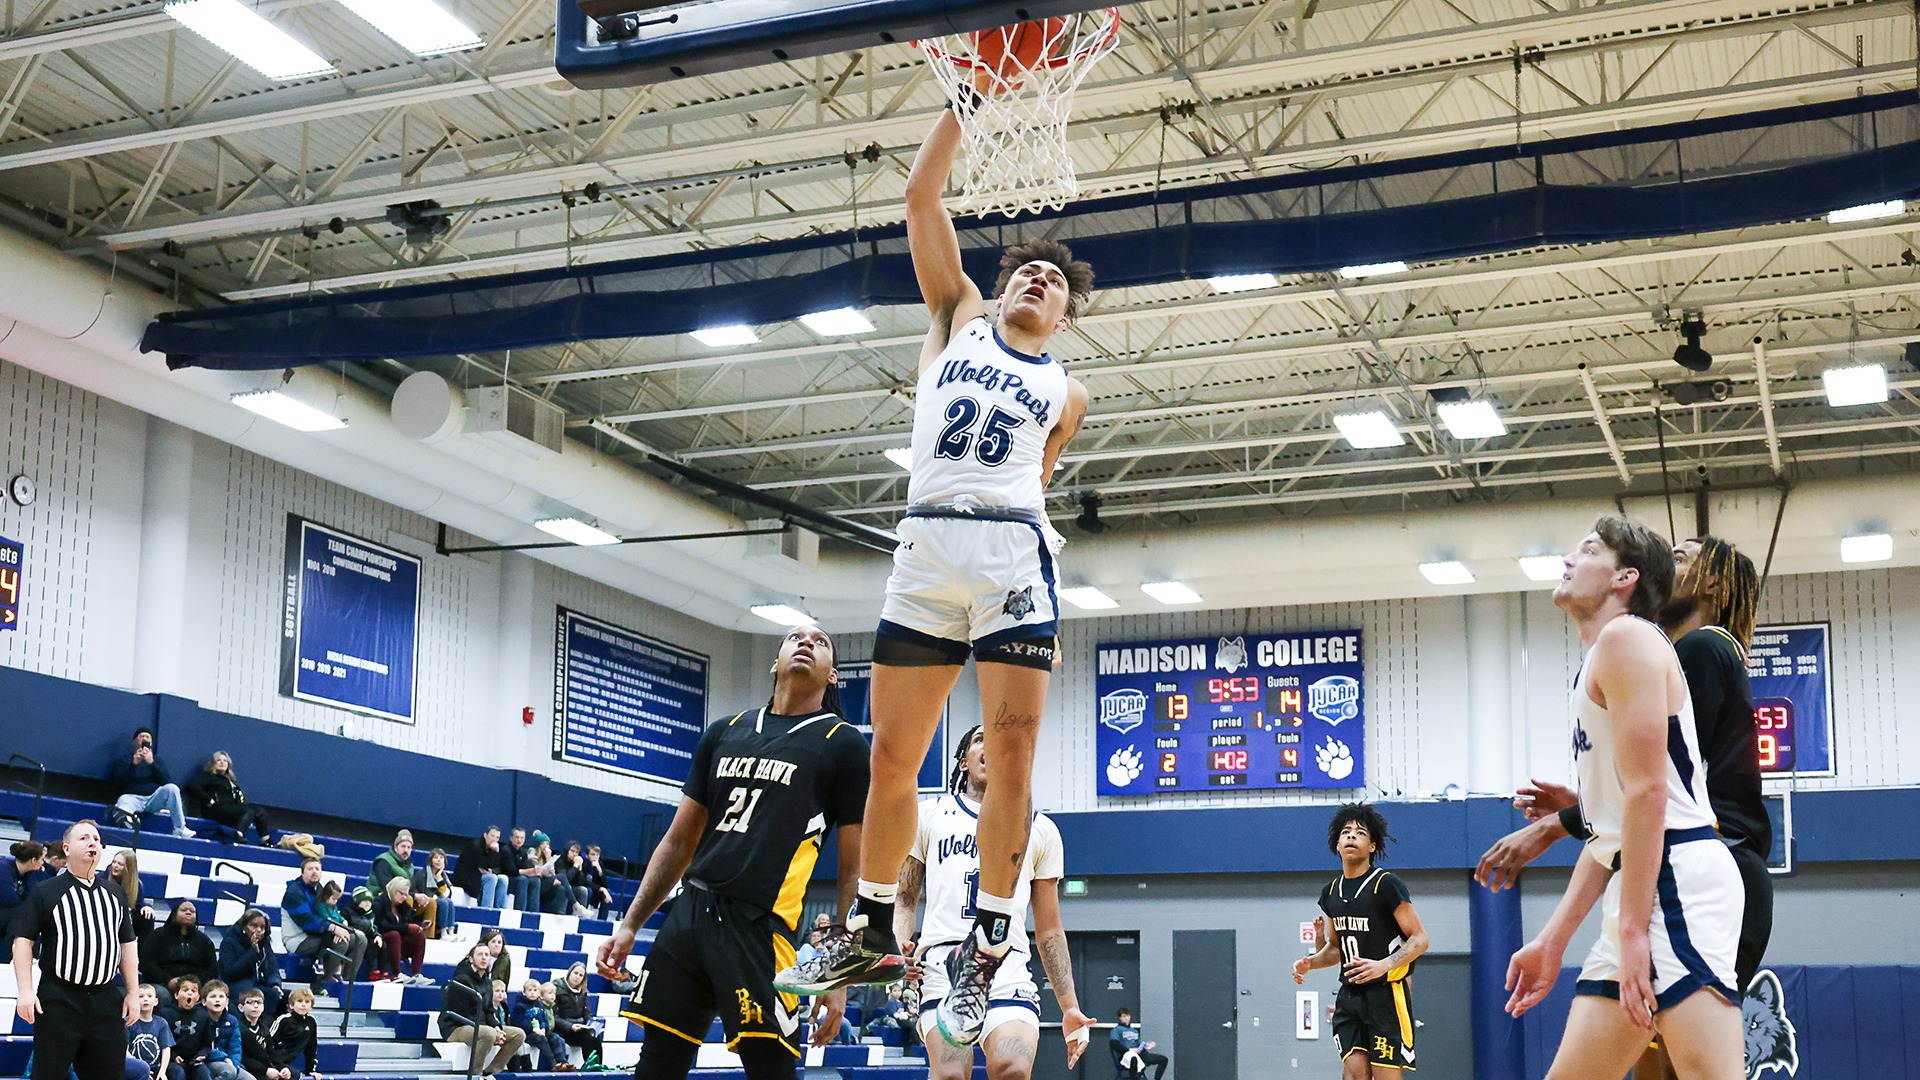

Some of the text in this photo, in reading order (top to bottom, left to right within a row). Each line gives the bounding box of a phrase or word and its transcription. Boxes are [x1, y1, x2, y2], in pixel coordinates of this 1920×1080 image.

[934, 396, 1026, 467] 25
[0, 547, 18, 565] sts
[0, 567, 18, 605] 4
[285, 574, 297, 639] SOFTBALL
[555, 614, 565, 710] CHAMPIONSHIPS
[1099, 636, 1358, 675] MADISON COLLEGE
[1155, 682, 1177, 692] Home
[1208, 677, 1259, 703] 9:53
[1267, 676, 1300, 688] Guests
[1167, 694, 1189, 720] 13
[1280, 690, 1302, 714] 14
[1212, 711, 1263, 729] period 1
[1754, 707, 1788, 730] :53
[1156, 737, 1178, 748] fouls
[1212, 735, 1242, 747] player
[1277, 733, 1299, 744] fouls
[1163, 753, 1177, 773] 2
[1284, 749, 1297, 767] 4
[716, 756, 798, 786] BLACK HAWK
[1159, 777, 1176, 786] won
[1220, 775, 1236, 785] set
[1280, 773, 1298, 782] won
[715, 787, 763, 833] 21
[938, 833, 978, 864] Wolf
[1341, 936, 1360, 964] 10
